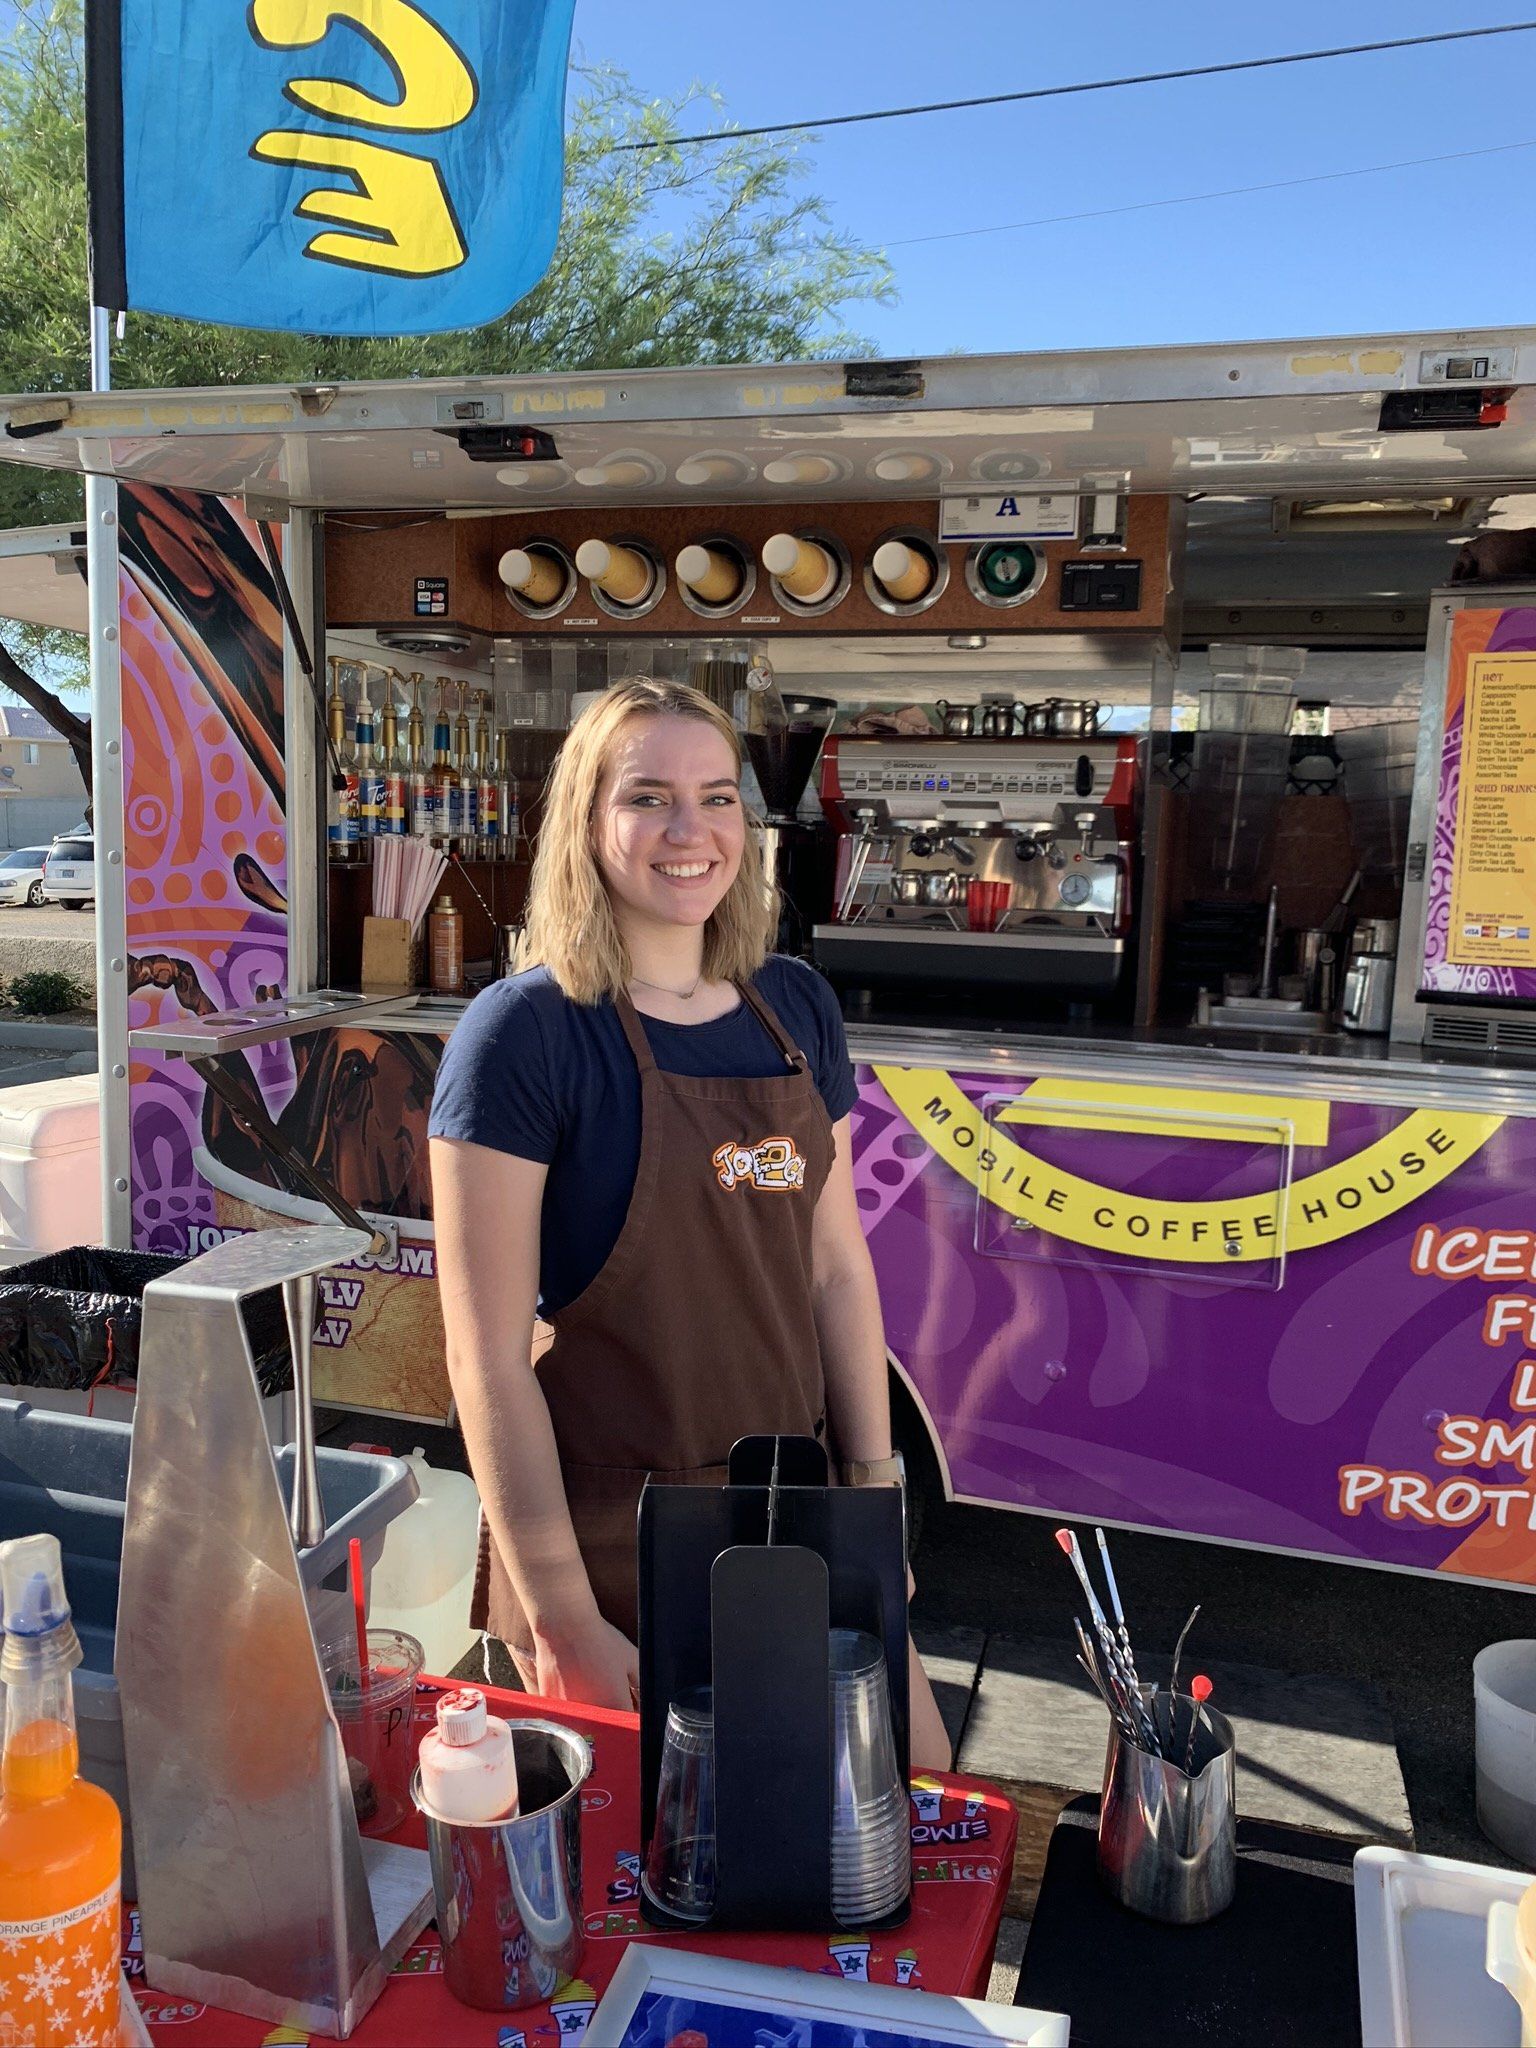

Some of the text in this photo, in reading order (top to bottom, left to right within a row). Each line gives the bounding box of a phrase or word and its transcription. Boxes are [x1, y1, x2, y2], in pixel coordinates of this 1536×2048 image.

[995, 497, 1021, 517] A
[1482, 673, 1504, 682] HOT
[1474, 784, 1498, 793] ICED
[922, 1096, 1456, 1243] MOBILE COFFEE HOUSE
[1415, 1229, 1536, 1276] ICE
[1343, 1468, 1536, 1531] PROT
[911, 1820, 988, 1842] OWIE
[52, 1891, 110, 1928] PINEAPPLE
